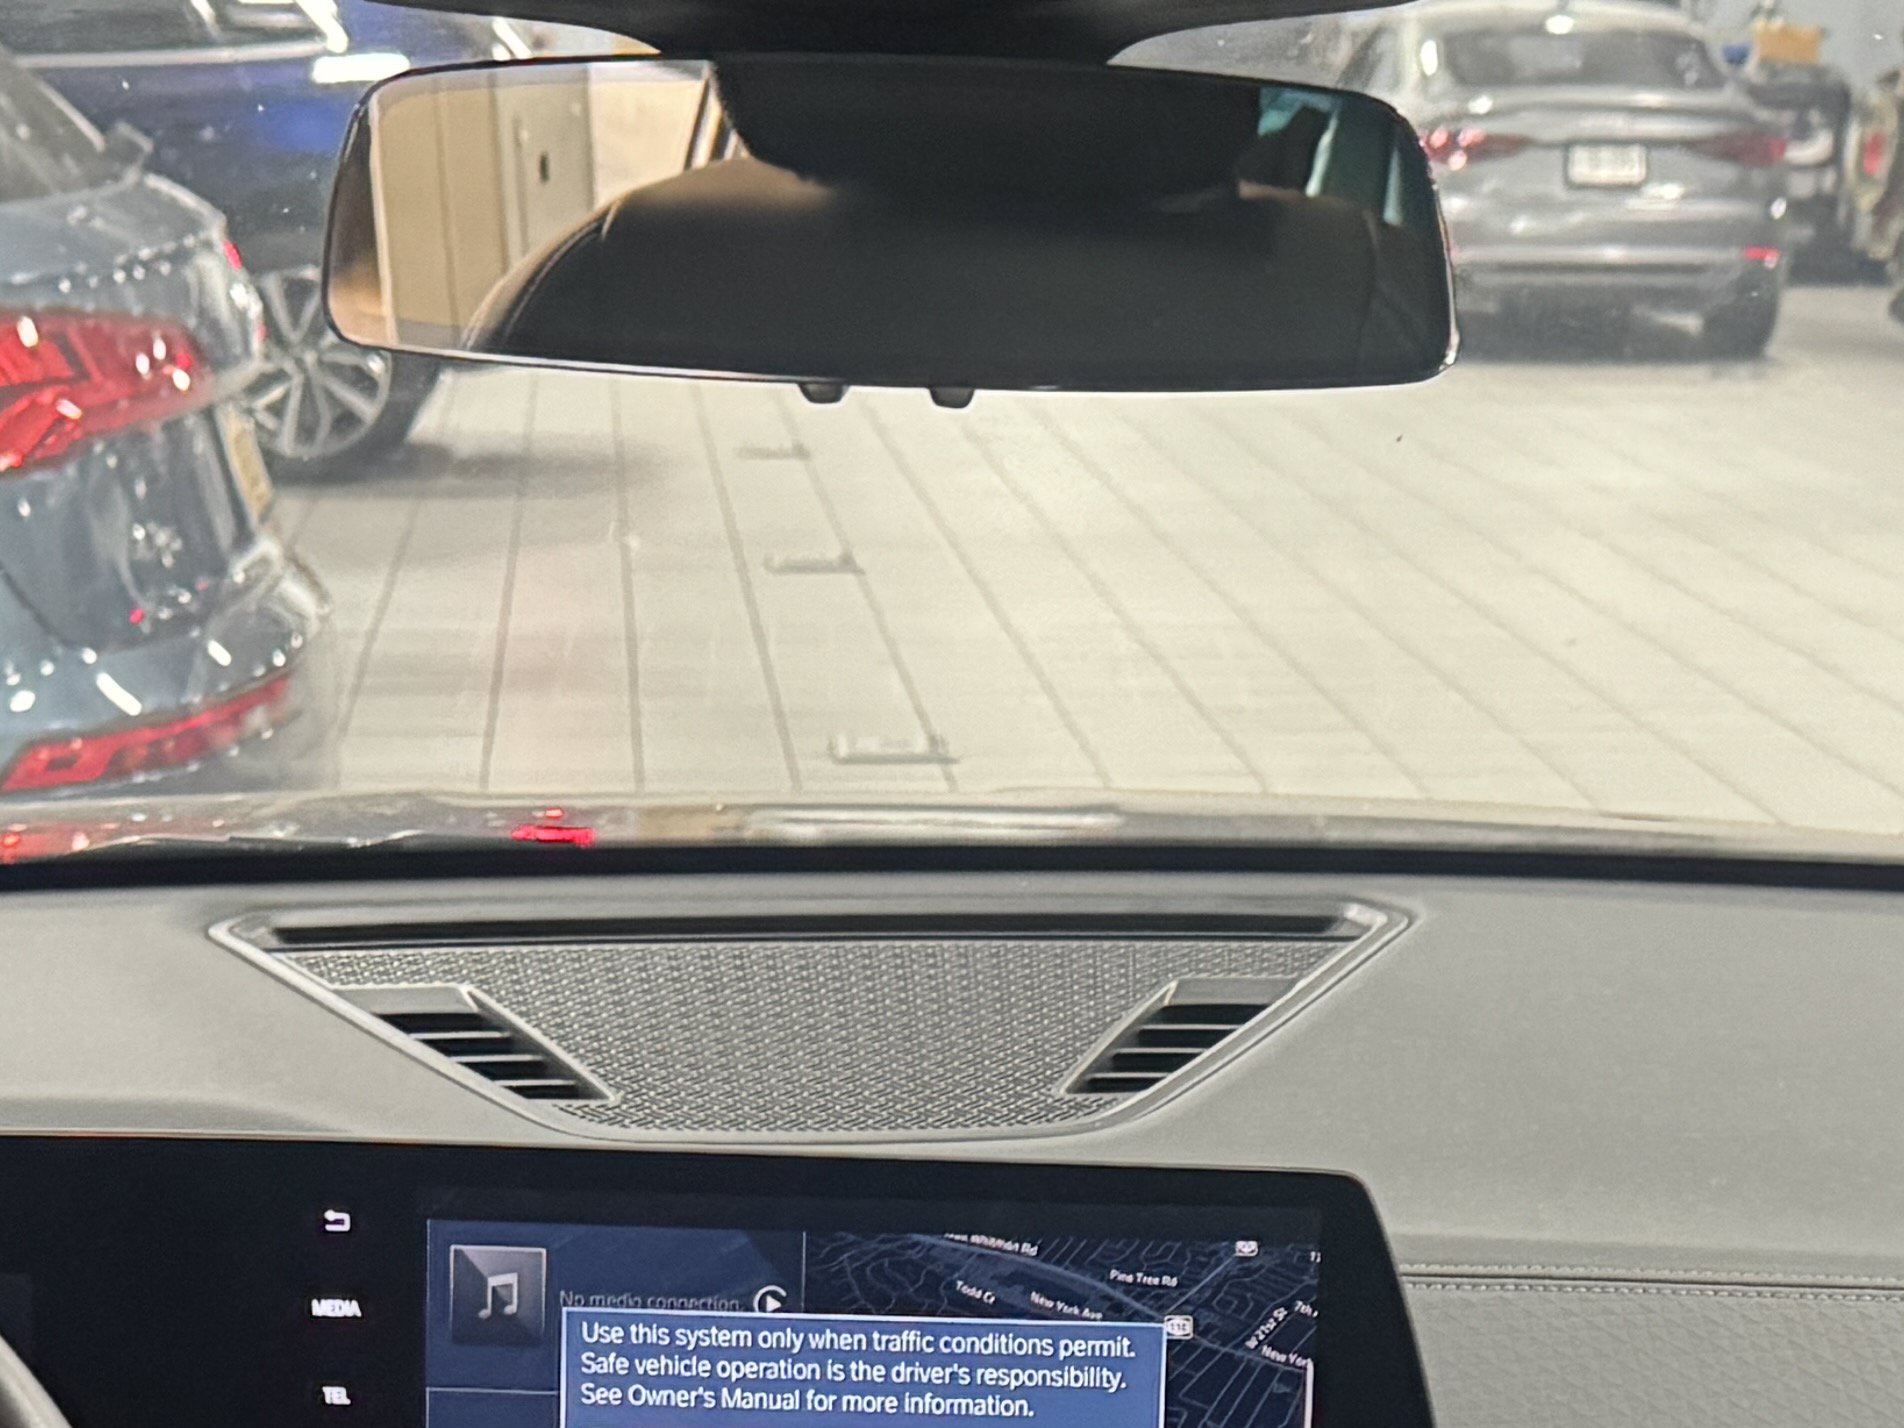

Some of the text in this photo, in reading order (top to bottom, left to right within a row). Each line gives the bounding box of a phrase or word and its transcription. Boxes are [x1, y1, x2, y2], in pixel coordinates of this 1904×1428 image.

[311, 1299, 362, 1318] MEDIA
[581, 1321, 1136, 1361] Use this system only when traffic conditions permit.
[580, 1351, 1127, 1393] Safe vehicle operation is the driver's responsibility.
[322, 1386, 352, 1406] TEL
[580, 1382, 1035, 1418] See Owner's Manual for more information.
